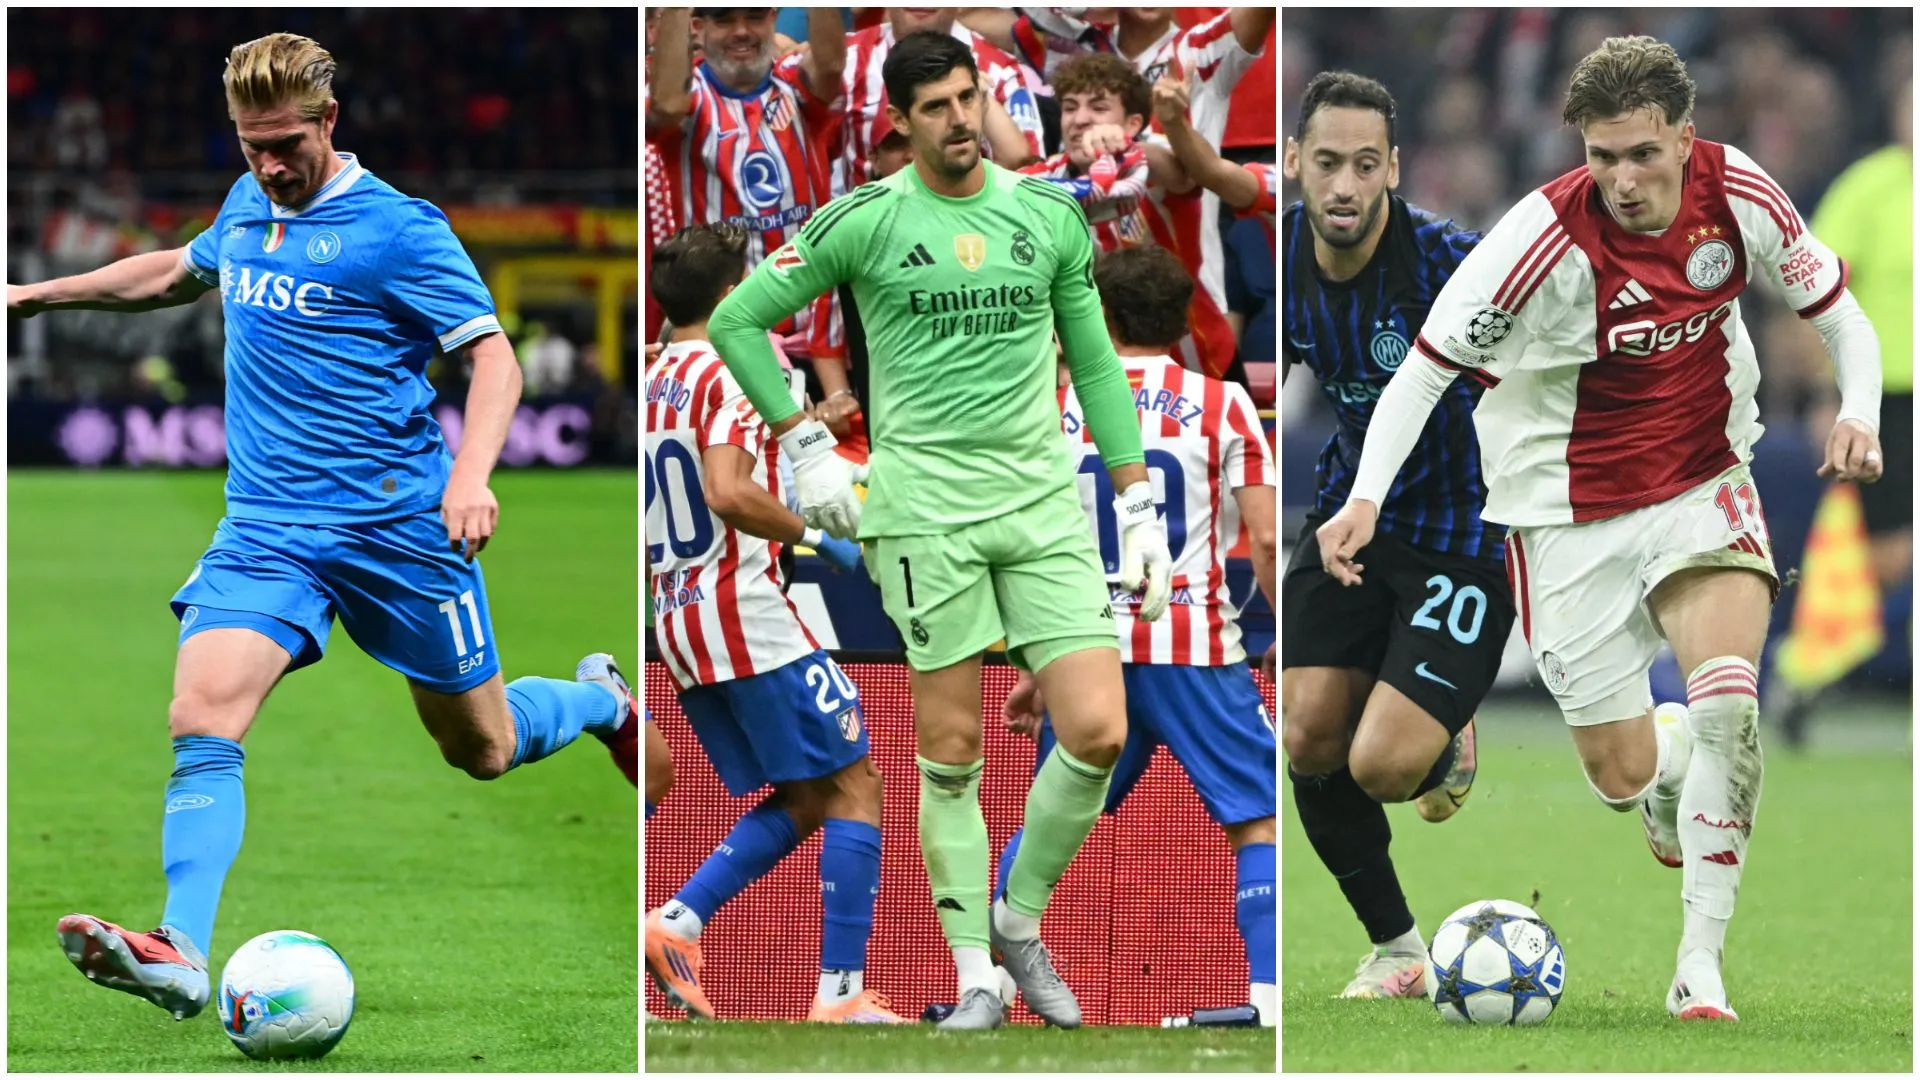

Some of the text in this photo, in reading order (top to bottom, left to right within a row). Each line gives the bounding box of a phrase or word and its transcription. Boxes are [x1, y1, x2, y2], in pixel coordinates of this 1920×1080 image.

[787, 205, 808, 221] AIR
[1779, 249, 1815, 276] ROCK
[1787, 245, 1805, 259] TEAM
[1782, 258, 1824, 287] STARS
[1803, 277, 1816, 292] IT
[233, 267, 333, 317] MSC
[909, 283, 1034, 316] Emirates
[931, 311, 1018, 339] FLY BETTER
[645, 377, 691, 412] LIANO
[1130, 388, 1204, 428] AREZ
[1126, 497, 1153, 515] URTOIS
[898, 556, 915, 608] 1
[438, 589, 486, 657] 11
[1410, 574, 1488, 645] 20
[458, 651, 485, 675] EA7
[805, 656, 859, 714] 20
